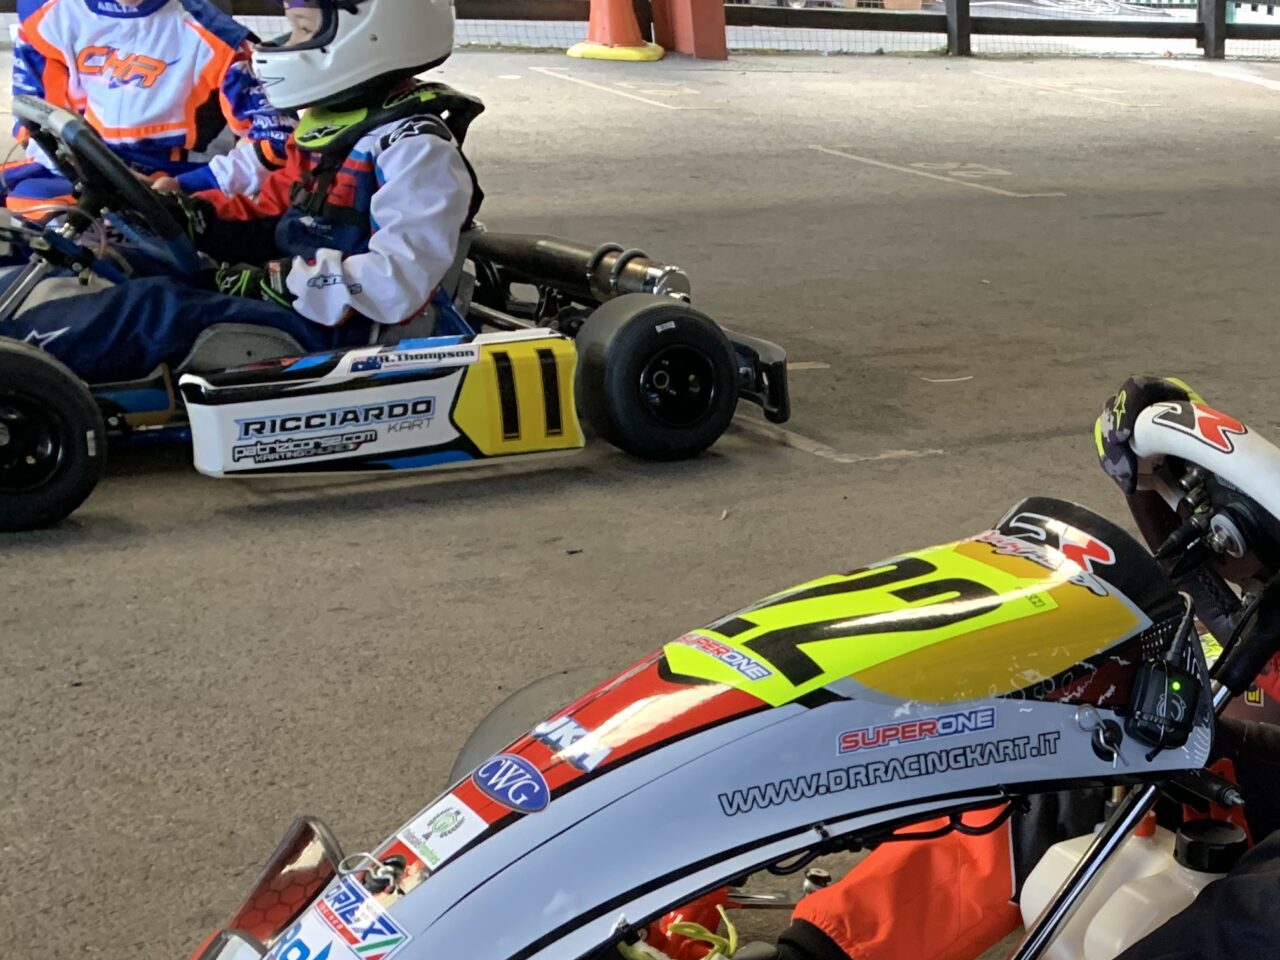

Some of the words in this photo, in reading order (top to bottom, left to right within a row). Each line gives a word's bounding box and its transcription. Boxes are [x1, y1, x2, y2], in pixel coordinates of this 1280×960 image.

[77, 45, 167, 88] CHR
[490, 347, 564, 441] 11
[240, 398, 434, 437] RICCIARDO
[387, 417, 434, 433] KART
[676, 634, 774, 682] SUPERONE
[839, 708, 995, 753] SUPERONE
[478, 758, 540, 806] CWG
[718, 731, 1061, 817] WWW.DRRACINGKART.IT
